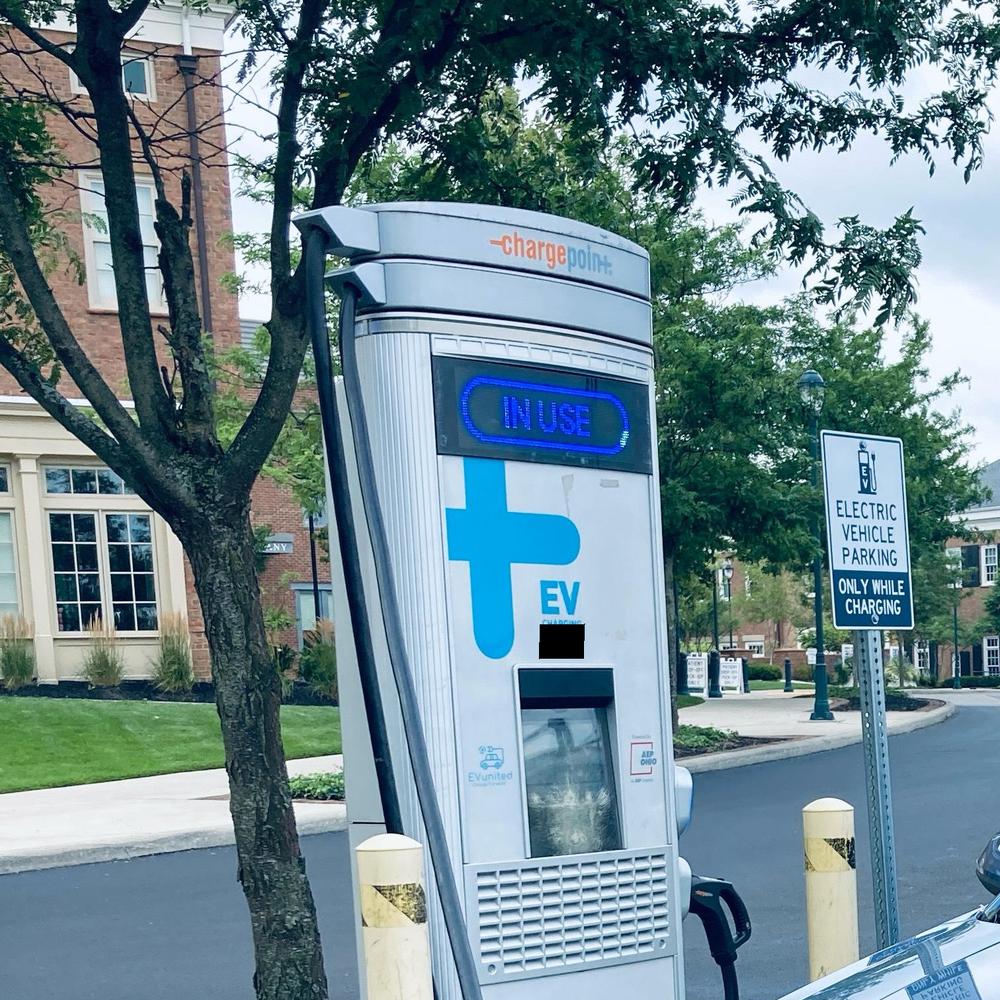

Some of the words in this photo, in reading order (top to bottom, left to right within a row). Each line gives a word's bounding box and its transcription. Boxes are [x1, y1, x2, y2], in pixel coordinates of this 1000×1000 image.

[503, 396, 531, 431] IN
[537, 400, 591, 437] USE
[836, 500, 897, 521] ELECTRIC
[842, 524, 895, 544] VEHICLE
[842, 547, 898, 567] PARKING
[838, 577, 869, 595] ONLY
[872, 579, 905, 596] WHILE
[540, 580, 580, 615] EV
[845, 598, 902, 616] CHARGING
